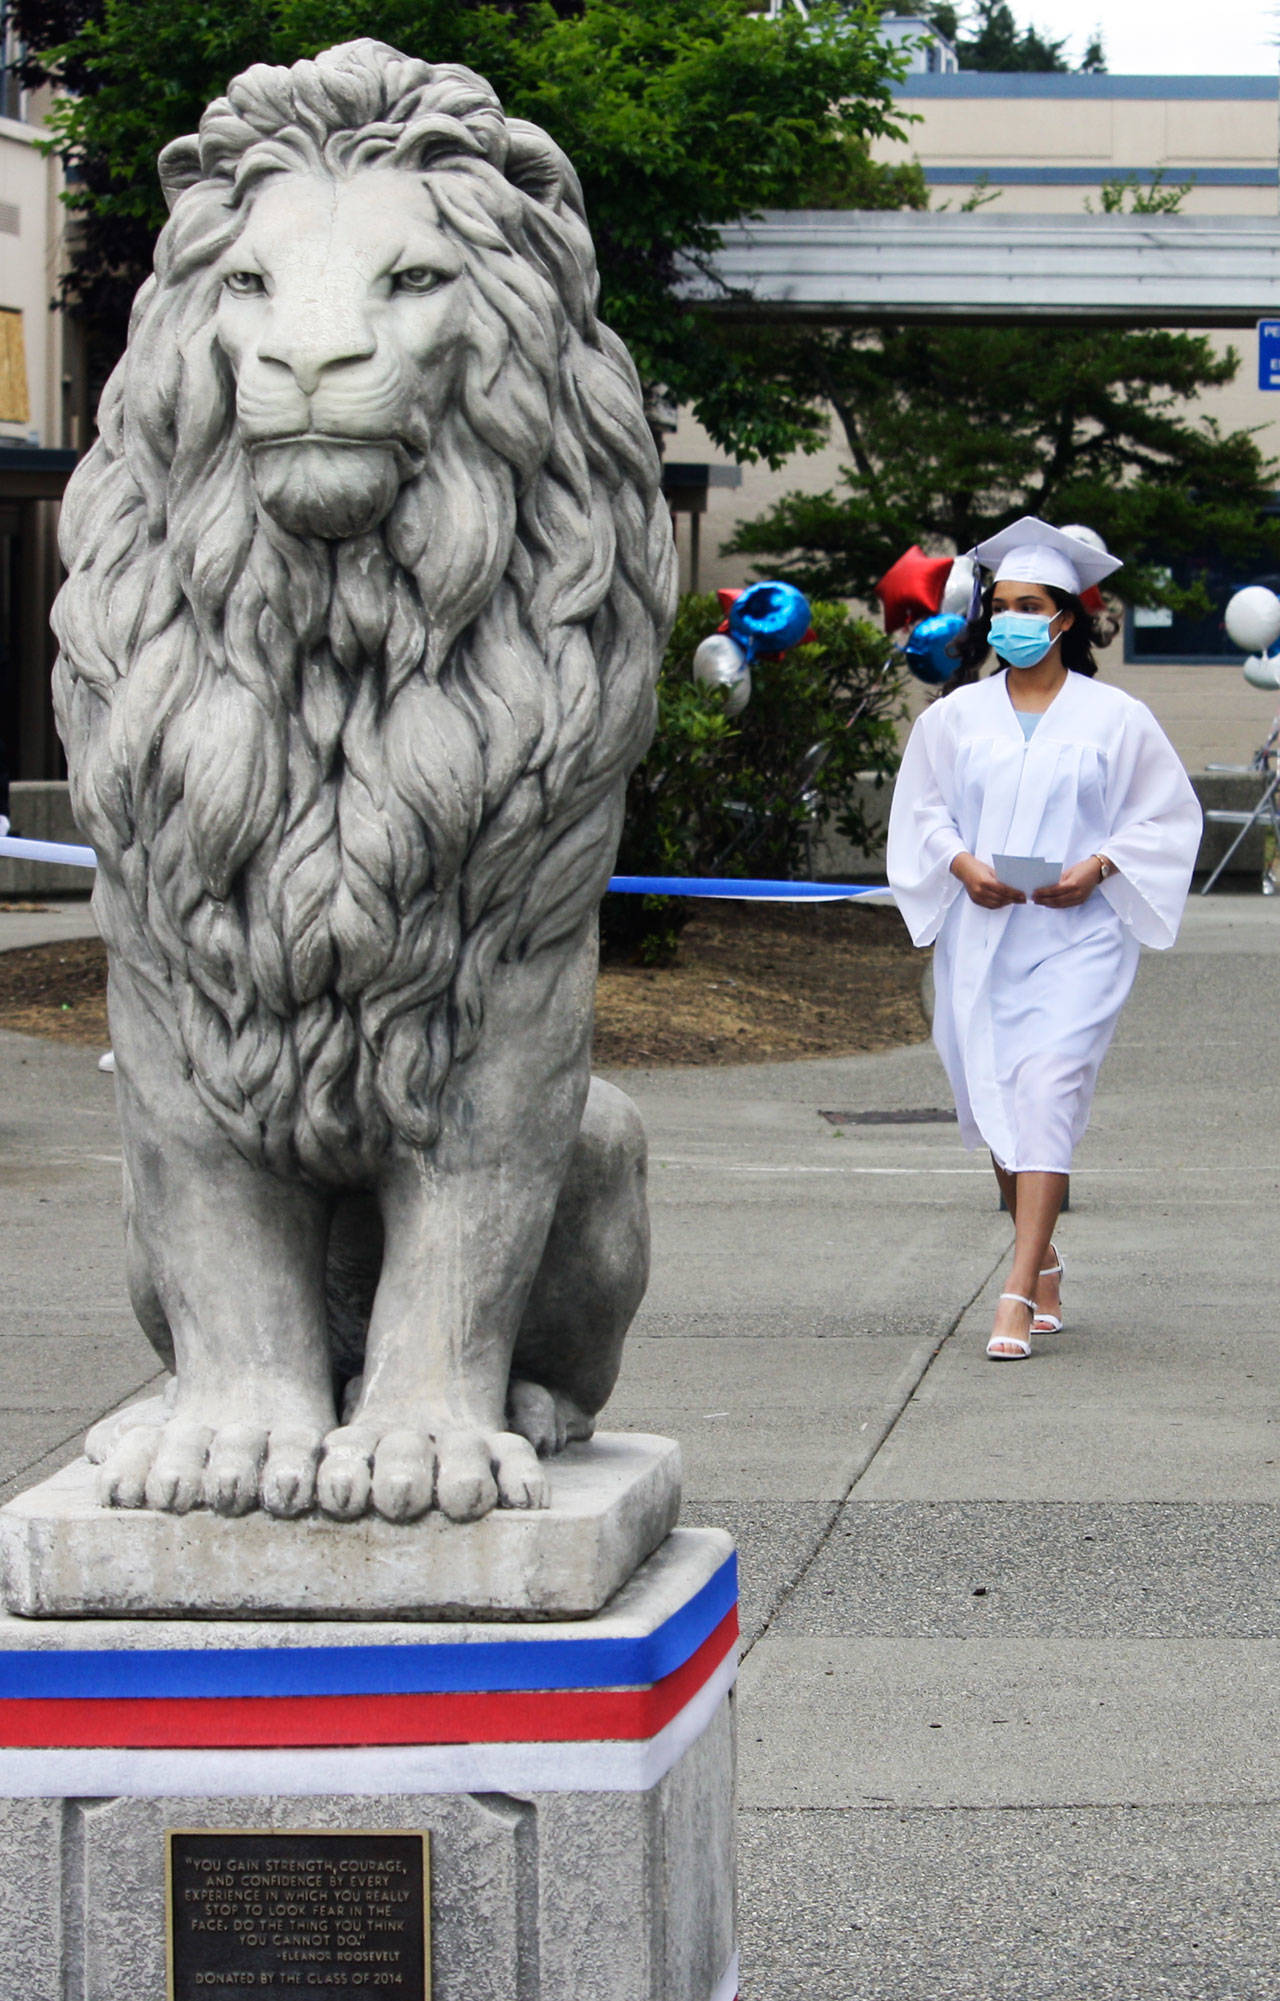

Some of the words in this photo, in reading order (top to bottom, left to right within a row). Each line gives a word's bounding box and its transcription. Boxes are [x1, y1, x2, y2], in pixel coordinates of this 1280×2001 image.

[227, 1860, 259, 1872] GAIN
[206, 1876, 234, 1886] AND
[241, 1876, 322, 1886] CONFIDENCE
[330, 1876, 343, 1886] BY
[351, 1876, 389, 1886] EVERY
[185, 1890, 260, 1901] EXPERIENCE
[266, 1890, 278, 1901] IN
[286, 1890, 327, 1901] WHICH
[334, 1890, 360, 1901] YOU
[366, 1891, 410, 1902] REALLY
[205, 1905, 238, 1916] STOP
[245, 1905, 262, 1916] TO
[269, 1905, 305, 1916] LOOK
[313, 1905, 344, 1916] FEAR
[350, 1905, 361, 1916] IN
[368, 1905, 391, 1916] THE
[234, 1920, 254, 1931] DO
[260, 1920, 283, 1931] THE
[290, 1920, 328, 1931] THING
[335, 1920, 361, 1931] YOU
[367, 1920, 404, 1932] THINK
[240, 1935, 265, 1946] YOU
[273, 1935, 330, 1946] CANNOT
[337, 1952, 400, 1961] ROOSEVELT
[196, 1973, 254, 1984] DONATED
[260, 1973, 275, 1984] BY
[281, 1973, 300, 1984] THE
[308, 1973, 347, 1984] CLASS
[352, 1973, 369, 1984] OF
[374, 1973, 402, 1984] 2014
